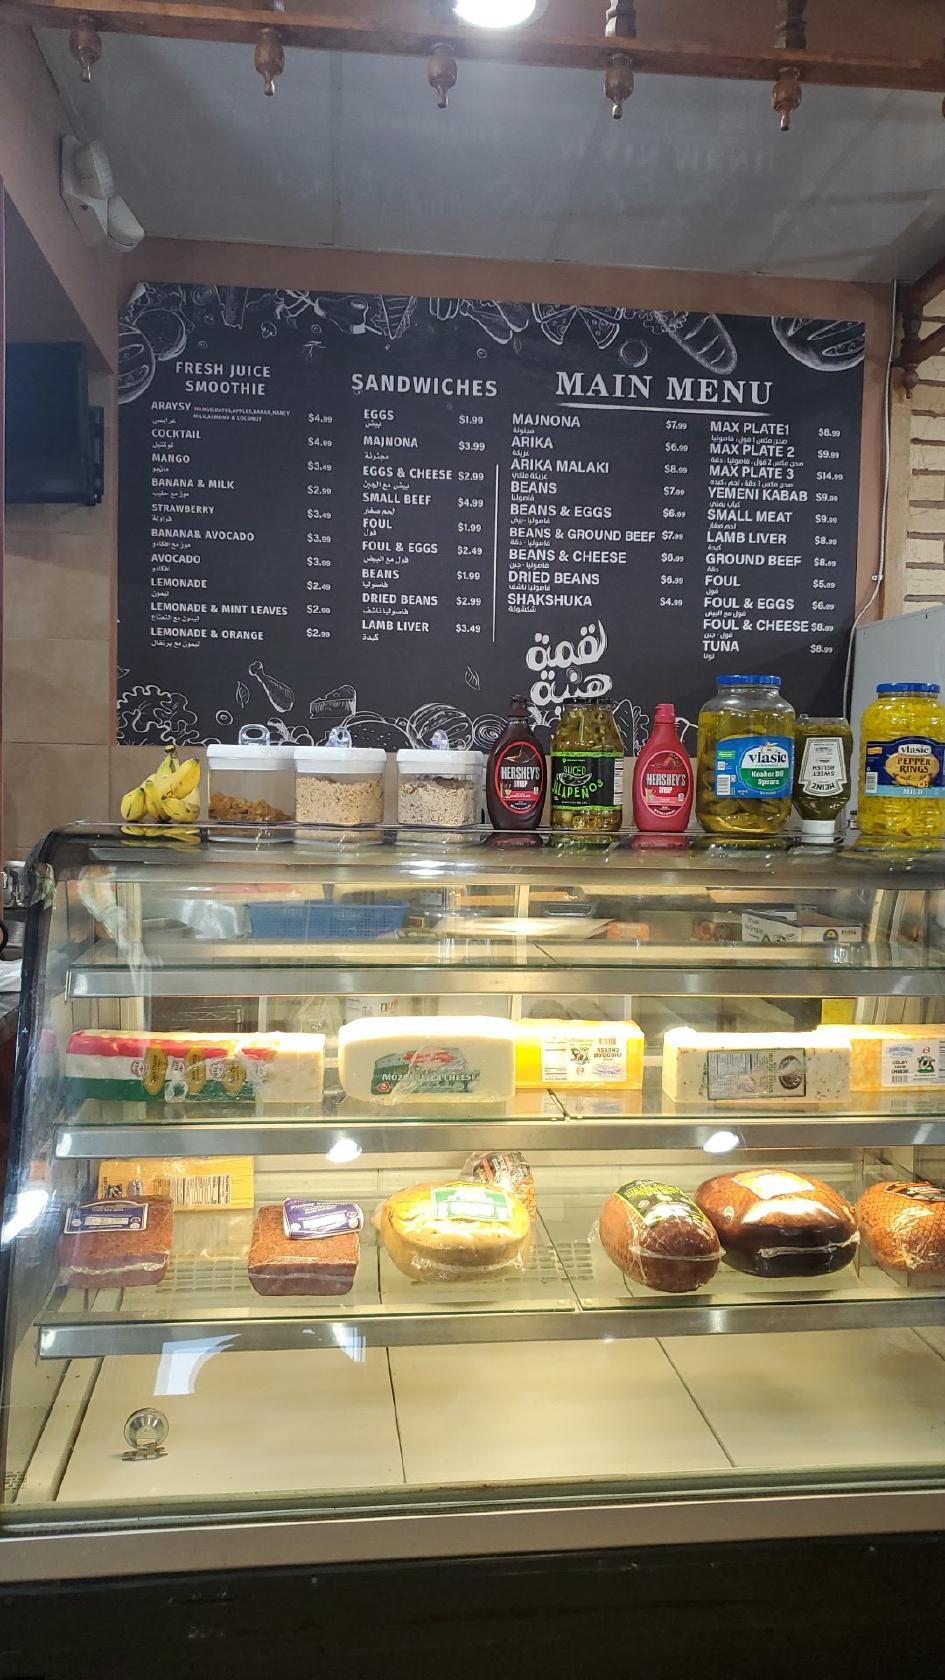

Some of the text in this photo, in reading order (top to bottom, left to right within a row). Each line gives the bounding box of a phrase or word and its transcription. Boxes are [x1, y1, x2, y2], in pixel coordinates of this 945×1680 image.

[176, 362, 270, 378] FRESH JUICE
[186, 381, 265, 395] SMOOTHIE
[352, 374, 497, 396] SANDWICHES
[556, 372, 773, 404] MAIN MENU
[151, 401, 191, 410] ARAYSY
[309, 413, 332, 423] $4.99
[364, 409, 394, 420] EGGS
[459, 415, 483, 424] $1.99
[513, 413, 580, 427] MAJNONA
[666, 420, 687, 429] $7.99
[711, 421, 788, 435] MAX PLATE1
[819, 428, 840, 437] $8.99
[152, 429, 201, 438] COCKTAIL
[364, 436, 418, 447] MAJNONA
[459, 441, 485, 451] $3.99
[512, 436, 553, 448] ARIKA
[665, 442, 688, 451] $6.99
[710, 443, 794, 457] MAX PLATE 2
[818, 450, 839, 458] $9.99
[152, 453, 190, 463] MANGO
[308, 461, 331, 471] $3.49
[511, 458, 608, 473] ARIKA MALAKI
[665, 465, 687, 473] $8.99
[363, 466, 452, 479] EGGS & CHEESE
[458, 472, 484, 480] $2.99
[710, 465, 794, 479] MAX PLATE 3
[152, 478, 193, 487] BANANA
[209, 480, 234, 489] MILK
[511, 481, 556, 493] BEANS
[307, 485, 331, 494] $2.99
[664, 486, 684, 495] $7.99
[708, 487, 807, 501] YEMENI KABAB
[363, 493, 431, 505] SMALL BEEF
[458, 497, 483, 507] $4.99
[152, 504, 214, 514] STRAWBERRY
[307, 509, 331, 519] $3.49
[511, 504, 611, 518] BEANS & EGGS
[663, 508, 685, 518] $6.99
[708, 509, 792, 522] SMALL MEAT
[363, 518, 392, 528] FOUL
[458, 522, 481, 532] $1.99
[151, 529, 254, 541] BANANA& AVOCADO
[307, 533, 331, 542] $3.99
[510, 528, 655, 542] BEANS & GROUND BEEF
[662, 530, 683, 540] $7.99
[707, 531, 786, 544] LAMB LIVER
[363, 541, 437, 553] FOUL & EGGS
[458, 545, 482, 555] $2.49
[151, 554, 200, 563] AVOCADO
[509, 549, 626, 563] BEANS & CHEESE
[662, 553, 684, 562] $6.99
[706, 553, 801, 566] GROUND BEEF
[307, 557, 331, 566] $3.99
[362, 569, 399, 579] BEANS
[457, 571, 480, 580] $1.99
[509, 571, 599, 584] DRIED BEANS
[151, 578, 207, 588] LEMONADE
[661, 575, 683, 584] $6.99
[705, 575, 740, 586] FOUL
[362, 593, 437, 605] DRIED BEANS
[456, 597, 481, 605] $2.99
[508, 593, 592, 606] SHAKSHUKA
[660, 597, 682, 606] $4.99
[704, 597, 794, 610] FOUL & EGGS
[151, 602, 207, 612] LEMONADE
[222, 605, 248, 613] MINT
[251, 606, 287, 615] LEAVES
[362, 620, 429, 631] LAMB LIVER
[456, 624, 480, 633] $3.49
[704, 619, 808, 632] FOUL & CHEESE
[811, 623, 833, 632] $8.99
[151, 628, 263, 640] LEMONADE & ORANGE
[307, 628, 330, 637] $2.99
[702, 641, 739, 652] TUNA
[810, 644, 833, 653] $8.99
[901, 746, 930, 754] vlasic
[748, 752, 786, 763] vlasic
[897, 757, 931, 766] PEPPER
[501, 766, 540, 780] HERSHEY'S
[563, 765, 586, 776] SLICED
[899, 765, 929, 773] RINGS
[646, 773, 686, 786] HERSHEY'S
[811, 782, 835, 790] HEINZ
